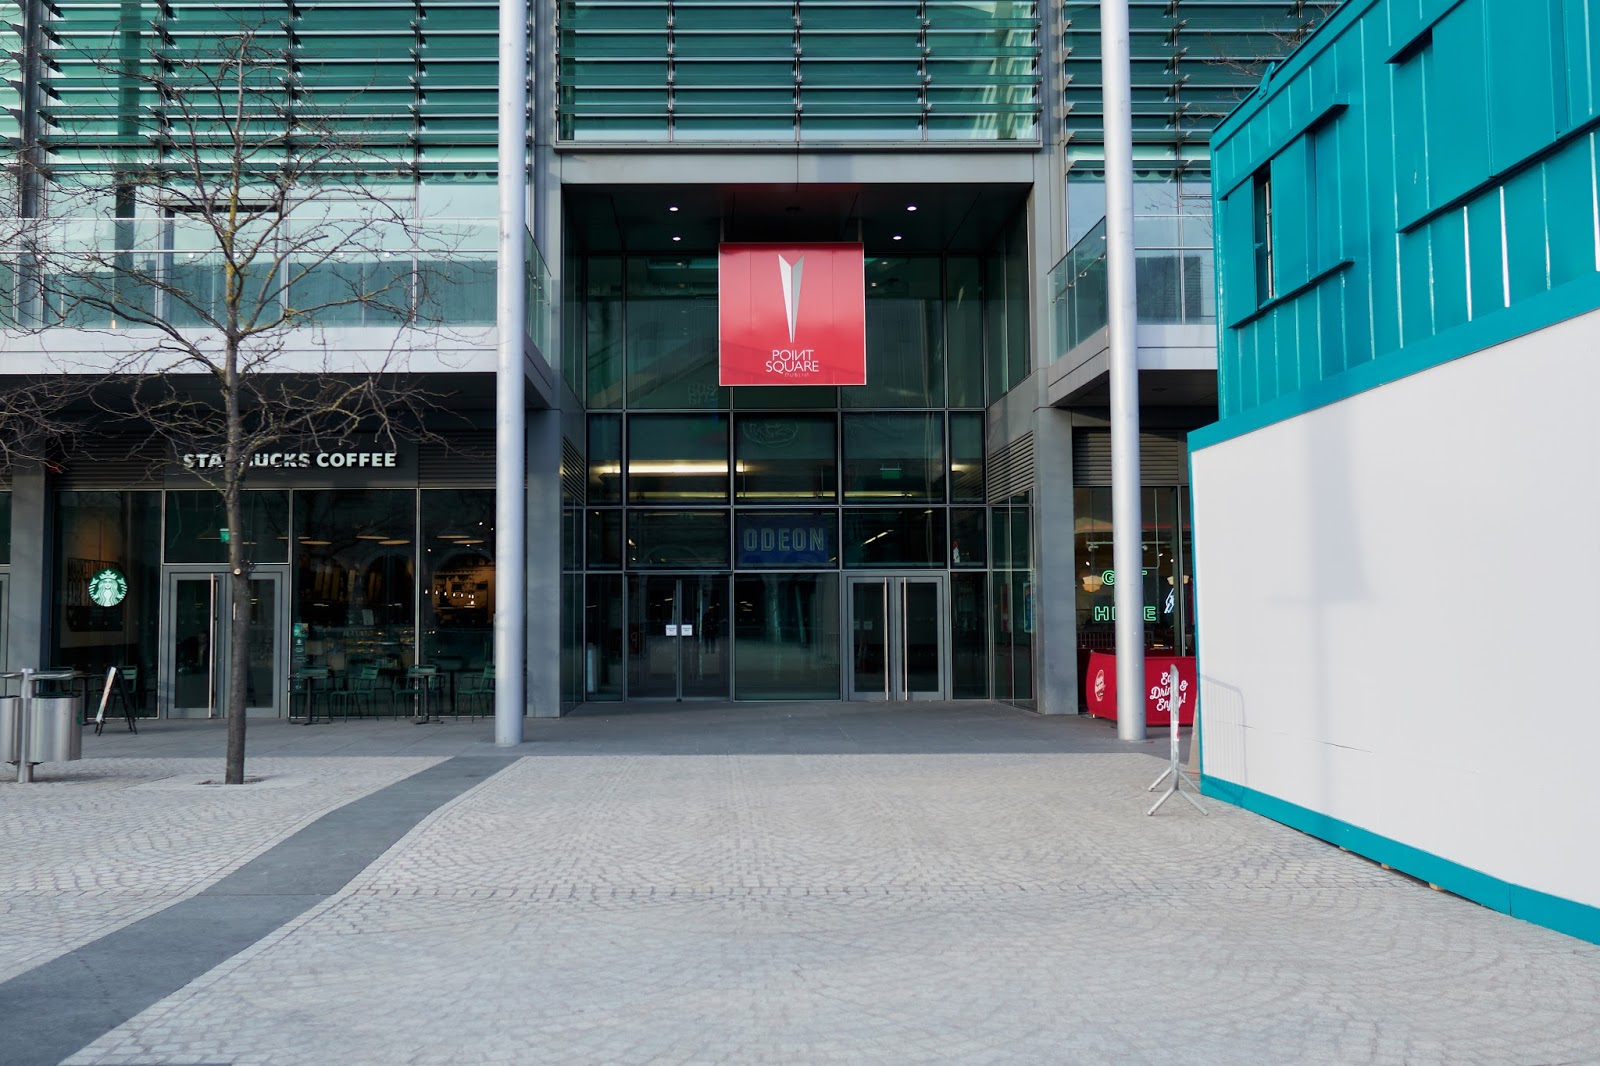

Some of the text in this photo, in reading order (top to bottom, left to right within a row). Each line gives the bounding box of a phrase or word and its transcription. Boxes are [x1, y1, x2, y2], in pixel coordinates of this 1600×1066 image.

[772, 349, 814, 361] POINT
[765, 360, 820, 374] SQUARE
[183, 452, 397, 468] STAUCKS COFFEE
[743, 527, 824, 552] ODEON
[1094, 605, 1157, 622] HE
[1150, 679, 1189, 700] Drin &
